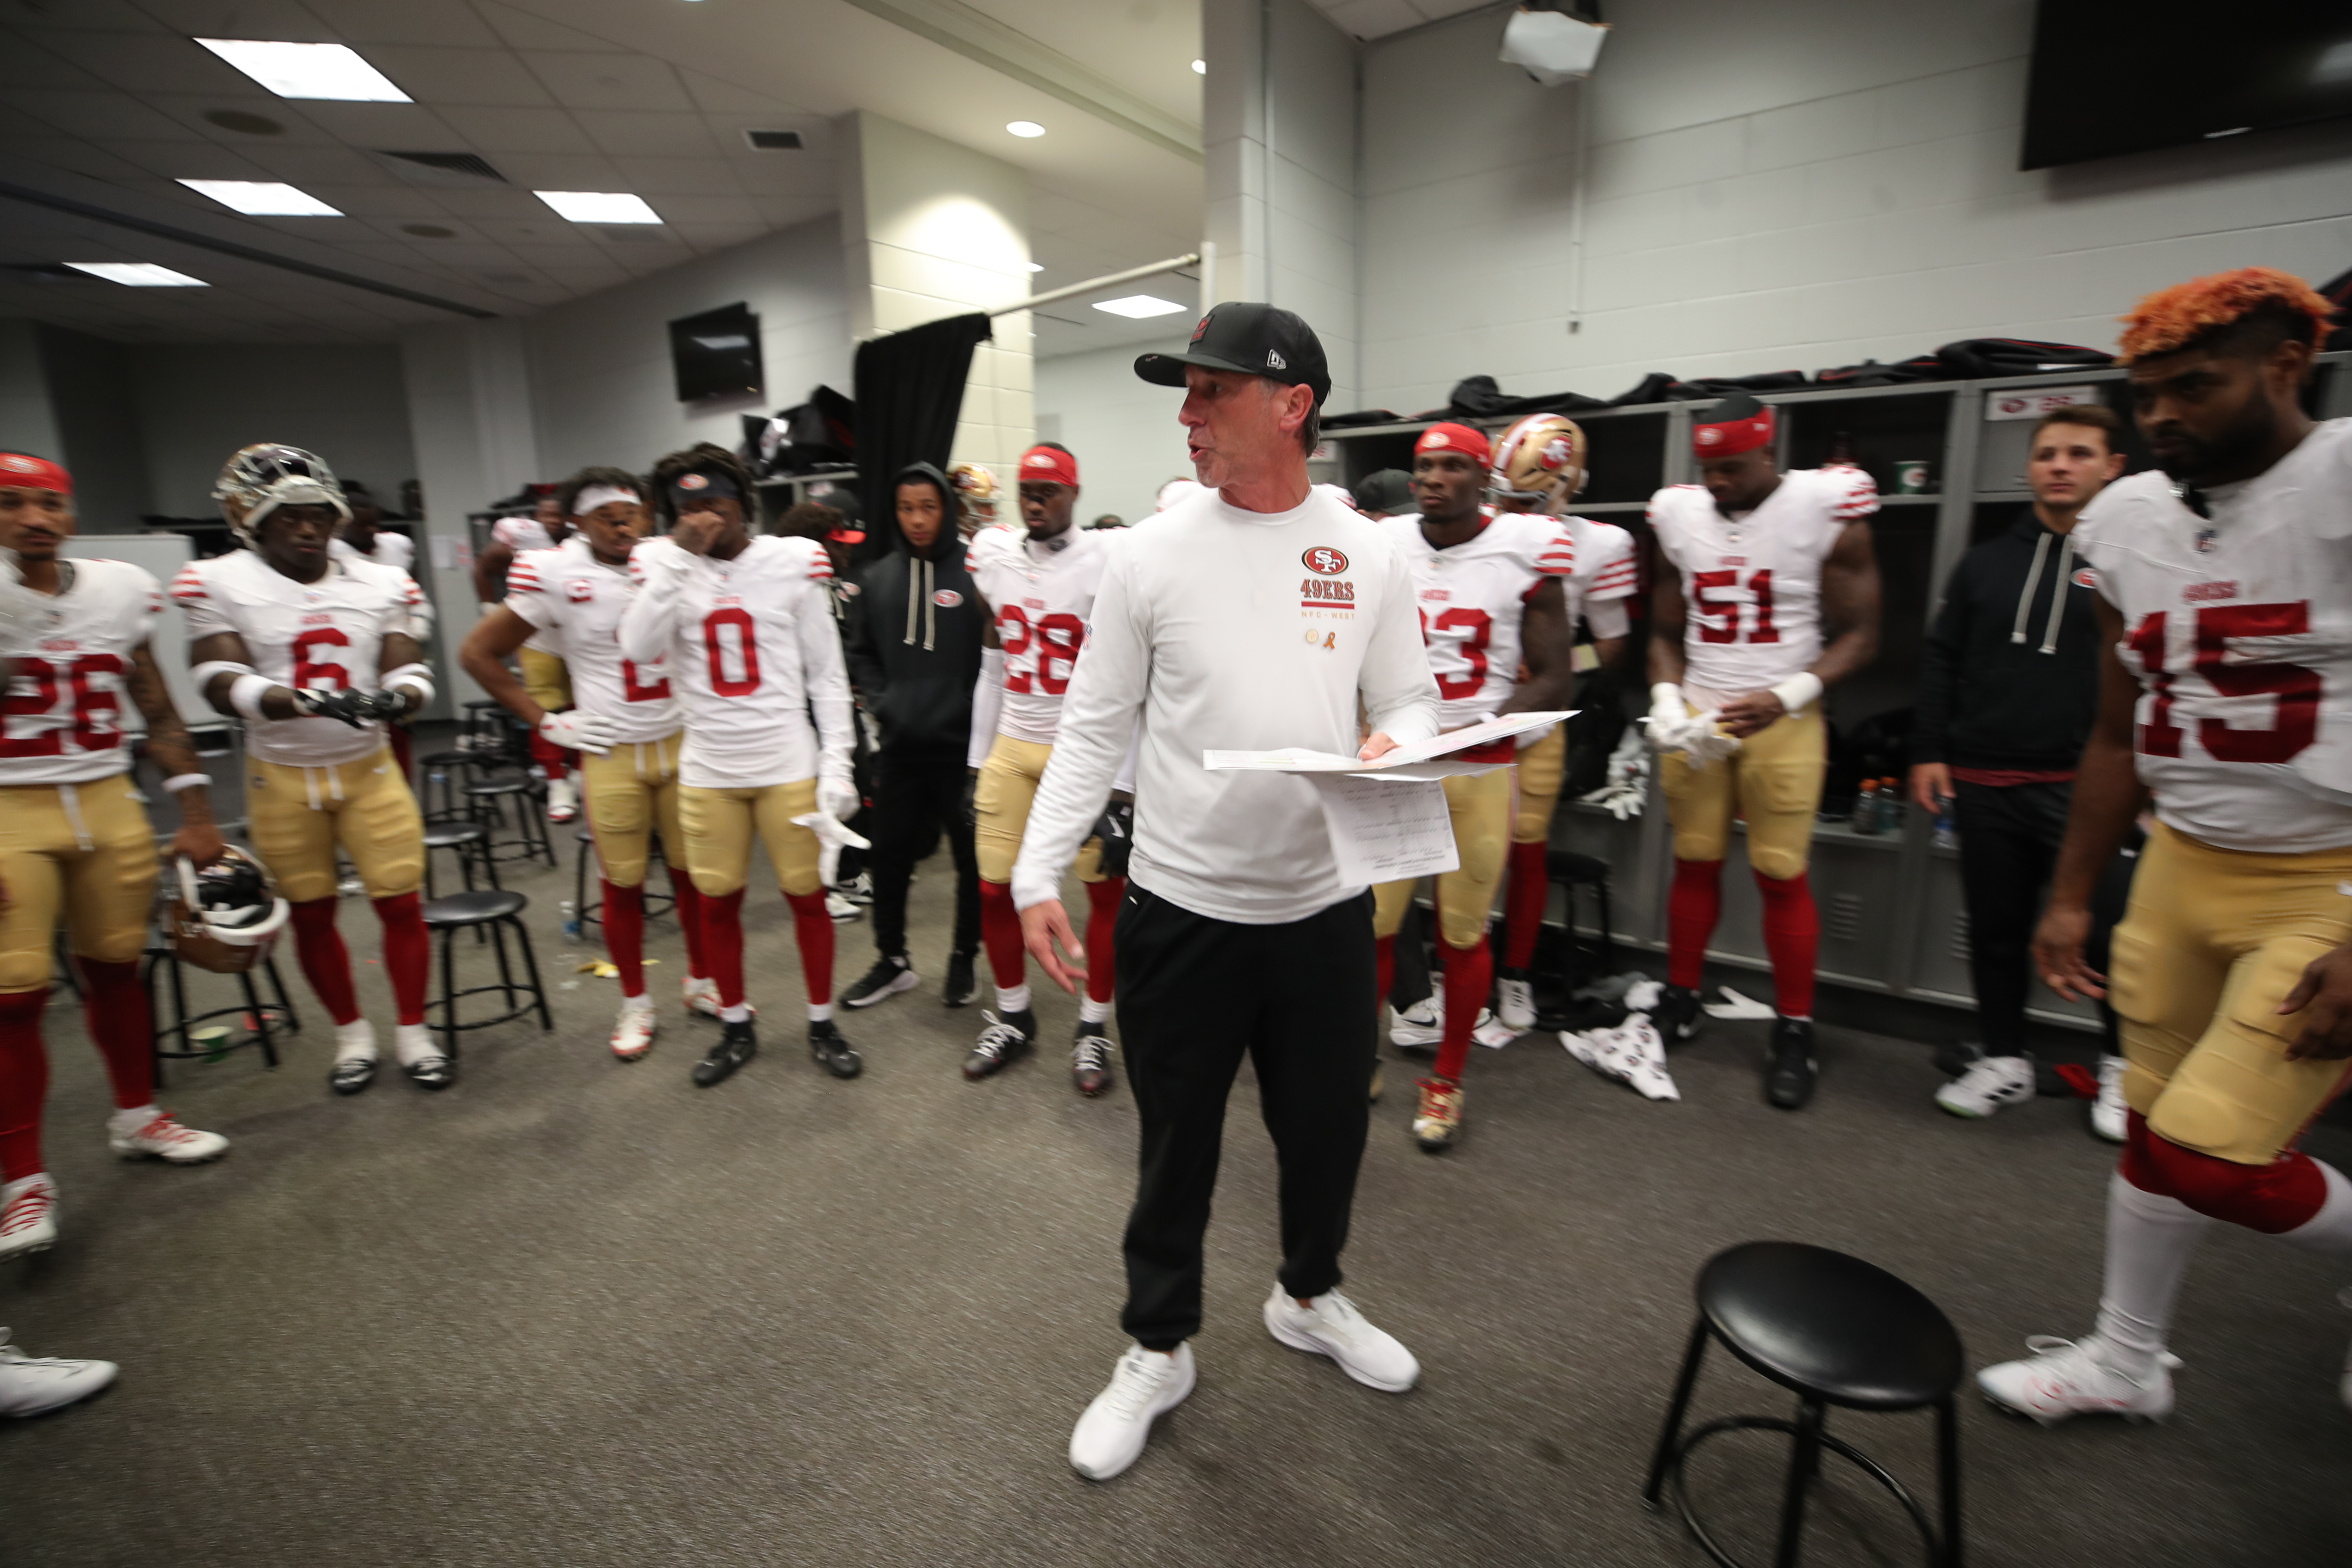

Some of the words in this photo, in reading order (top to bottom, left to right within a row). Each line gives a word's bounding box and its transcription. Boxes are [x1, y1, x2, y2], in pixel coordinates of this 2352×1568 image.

[1301, 579, 1354, 600] 49ERS
[1314, 549, 1341, 573] SF
[1694, 569, 1779, 643] 51
[995, 605, 1083, 694] 28
[1418, 606, 1491, 700] 3
[2124, 599, 2323, 763] 15
